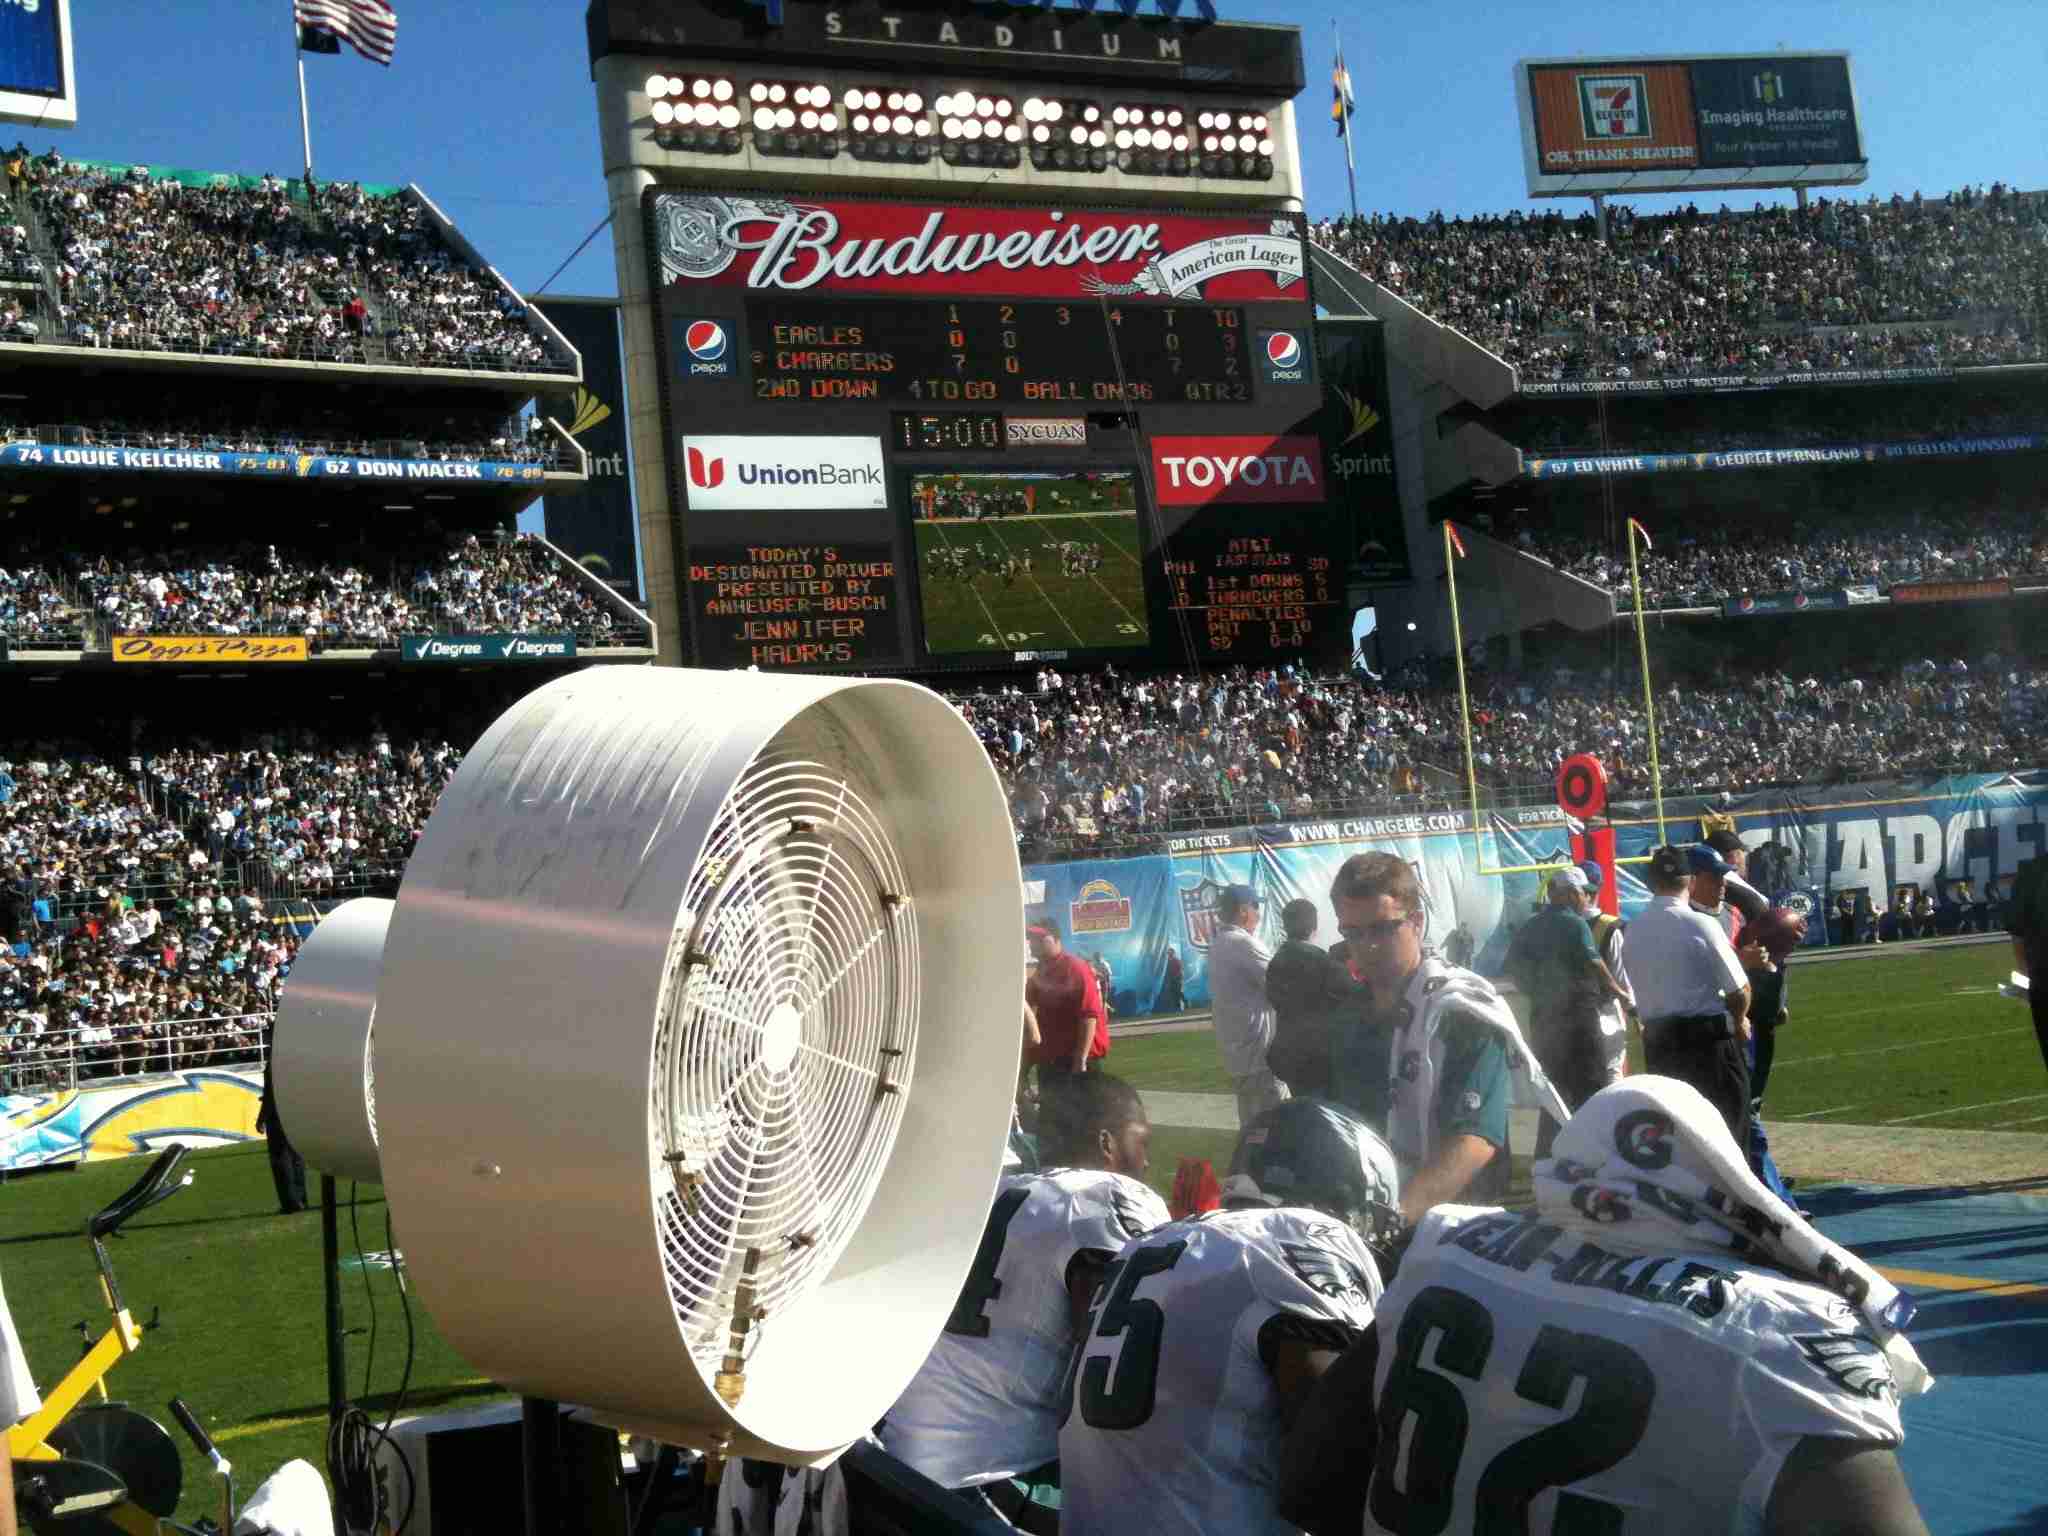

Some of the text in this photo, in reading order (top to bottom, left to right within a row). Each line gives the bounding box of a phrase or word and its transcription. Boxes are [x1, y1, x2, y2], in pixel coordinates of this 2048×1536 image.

[825, 12, 1182, 58] STADIUM
[1700, 109, 1764, 127] Imaging
[1766, 107, 1849, 123] Healthcare
[721, 209, 1160, 289] Budweiser
[1169, 244, 1299, 286] American Lager
[773, 324, 864, 345] EAGLES
[690, 362, 728, 376] pepsi
[776, 351, 895, 372] CHARGERS
[756, 378, 801, 399] 2ND
[810, 378, 880, 399] DOWN
[1023, 381, 1085, 400] BALL
[1581, 381, 1626, 393] CONDUCT
[902, 416, 999, 448] 15:00
[1007, 423, 1085, 440] SYCUAN
[17, 448, 44, 463] 74
[52, 449, 120, 466] LOUIE
[123, 451, 223, 470] KELCHER
[1331, 453, 1393, 481] Sprint
[1573, 460, 1593, 473] ED
[1595, 458, 1645, 473] WHITE
[1715, 450, 1774, 467] GEORGE
[325, 460, 350, 475] 62
[357, 460, 403, 477] DON
[406, 462, 483, 478] MACEK
[738, 462, 882, 488] UnionBank
[1160, 455, 1317, 488] TOYOTA
[748, 547, 838, 562] TODAY'S
[689, 562, 897, 581] DESIGNATED DRIVER
[717, 579, 873, 598] PRESENTED BY
[704, 596, 888, 615] ANHEUSER-BUSCH
[735, 617, 865, 640] JENNIFER
[120, 639, 298, 660] Oggi's Pizza
[431, 642, 483, 658] Degree
[516, 641, 567, 657] Degree
[1288, 811, 1466, 842] WWW.CHARGERS.COM
[1188, 834, 1233, 849] TICKETS
[1787, 898, 1811, 911] FOX
[1367, 1284, 1658, 1536] 62
